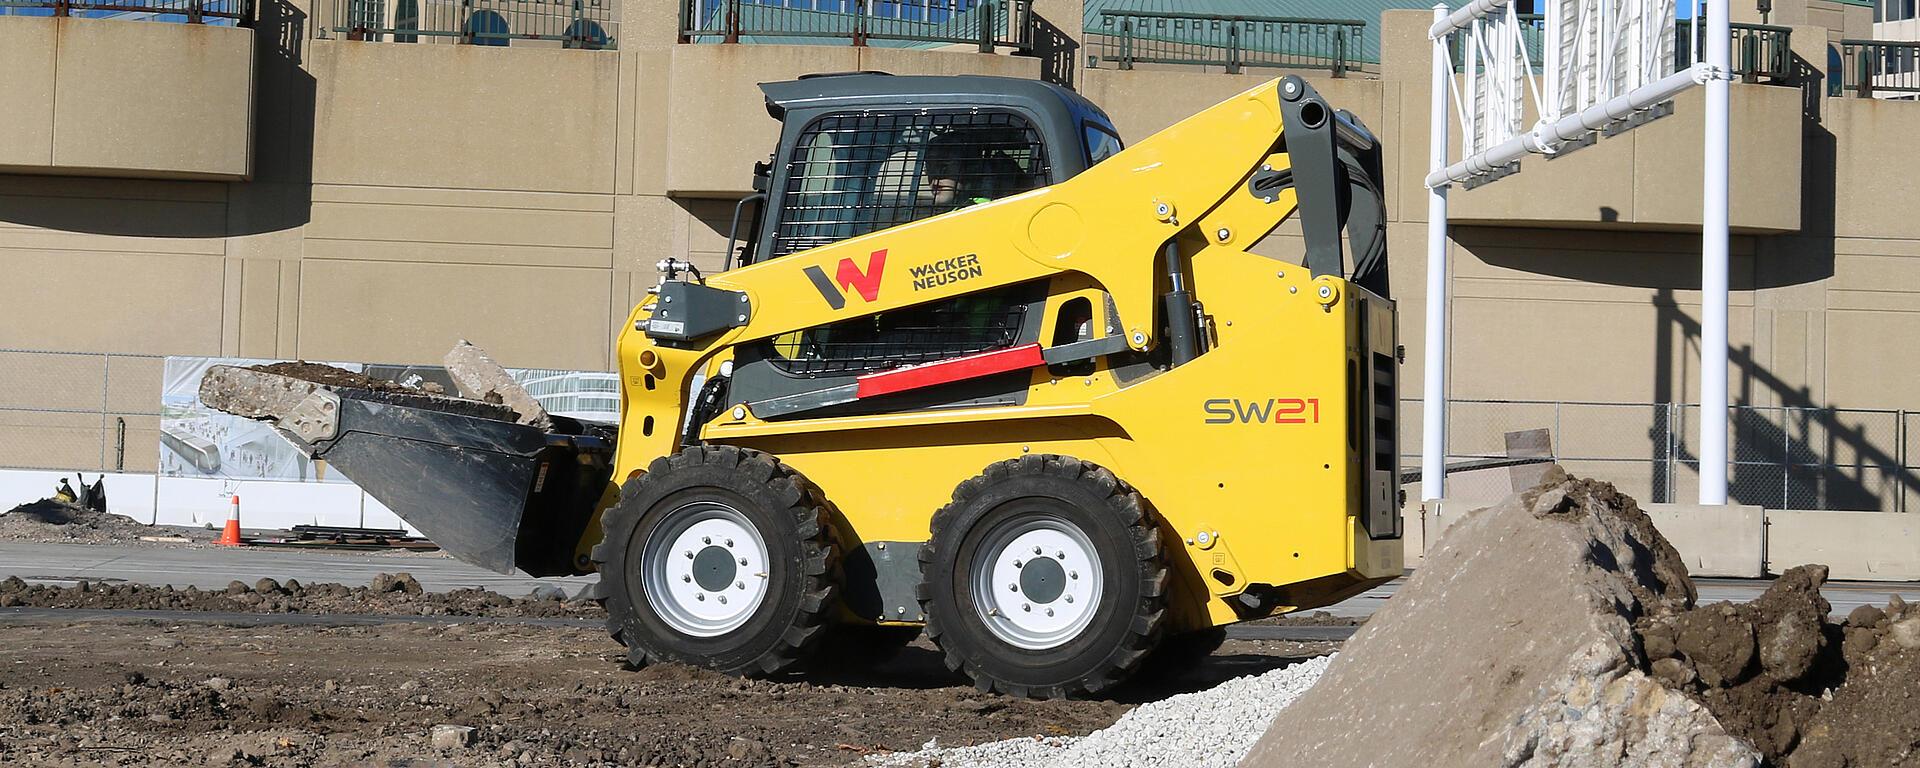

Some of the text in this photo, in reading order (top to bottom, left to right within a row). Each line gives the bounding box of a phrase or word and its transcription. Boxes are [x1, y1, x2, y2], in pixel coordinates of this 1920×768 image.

[909, 253, 980, 279] WACKER
[913, 265, 983, 291] NEUSON
[1204, 398, 1319, 424] SW21
